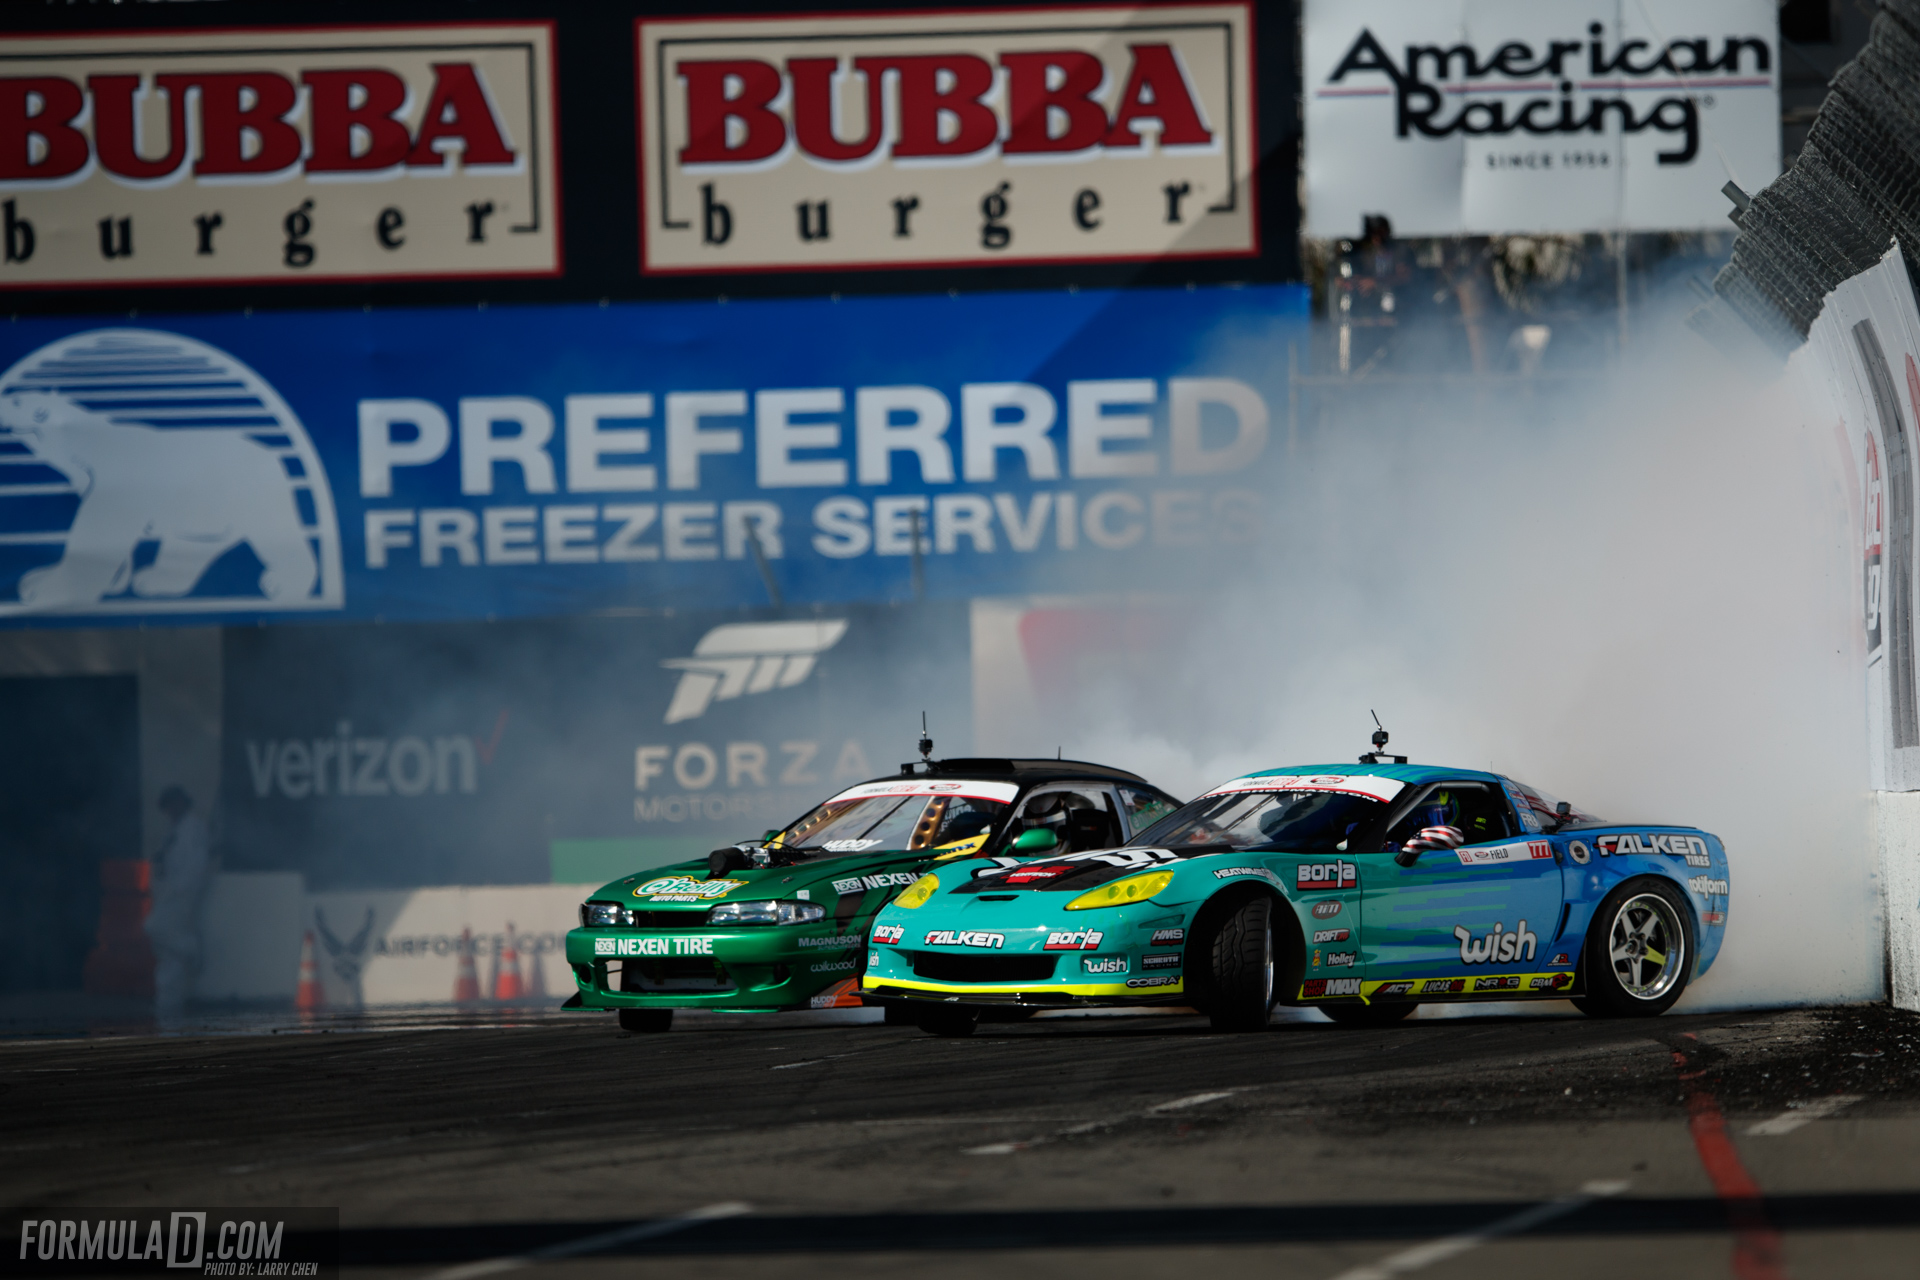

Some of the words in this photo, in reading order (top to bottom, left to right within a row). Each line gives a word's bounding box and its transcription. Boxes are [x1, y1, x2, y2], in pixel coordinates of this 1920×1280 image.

[1327, 22, 1770, 82] American
[676, 42, 1218, 171] BUBBA
[0, 62, 521, 184] BUBBA
[1393, 82, 1700, 164] Racing
[1486, 150, 1553, 169] SINCE
[702, 181, 1191, 250] burger
[4, 198, 496, 268] burger
[357, 377, 1269, 497] PREFERRED
[365, 500, 784, 568] FREEZER
[812, 487, 1262, 559] SERVICES
[246, 720, 477, 798] verizon
[634, 739, 872, 791] FORZA
[1490, 848, 1509, 860] FIELD
[1529, 843, 1551, 859] 777
[1595, 834, 1710, 857] FALKEN
[1685, 855, 1711, 868] TIRES
[863, 872, 919, 890] NEXEN
[798, 935, 861, 947] MAGNUSON
[924, 930, 1005, 949] FALKEN
[1152, 929, 1184, 940] HMS
[1454, 920, 1537, 965] wish
[618, 939, 670, 955] NEXEN
[672, 938, 713, 954] TIRE
[810, 958, 856, 972] wilwood
[1084, 957, 1129, 973] wish
[1327, 952, 1356, 967] Holley
[1126, 976, 1178, 987] COBRA
[1325, 978, 1362, 995] MAX
[1423, 981, 1451, 992] LUCAS
